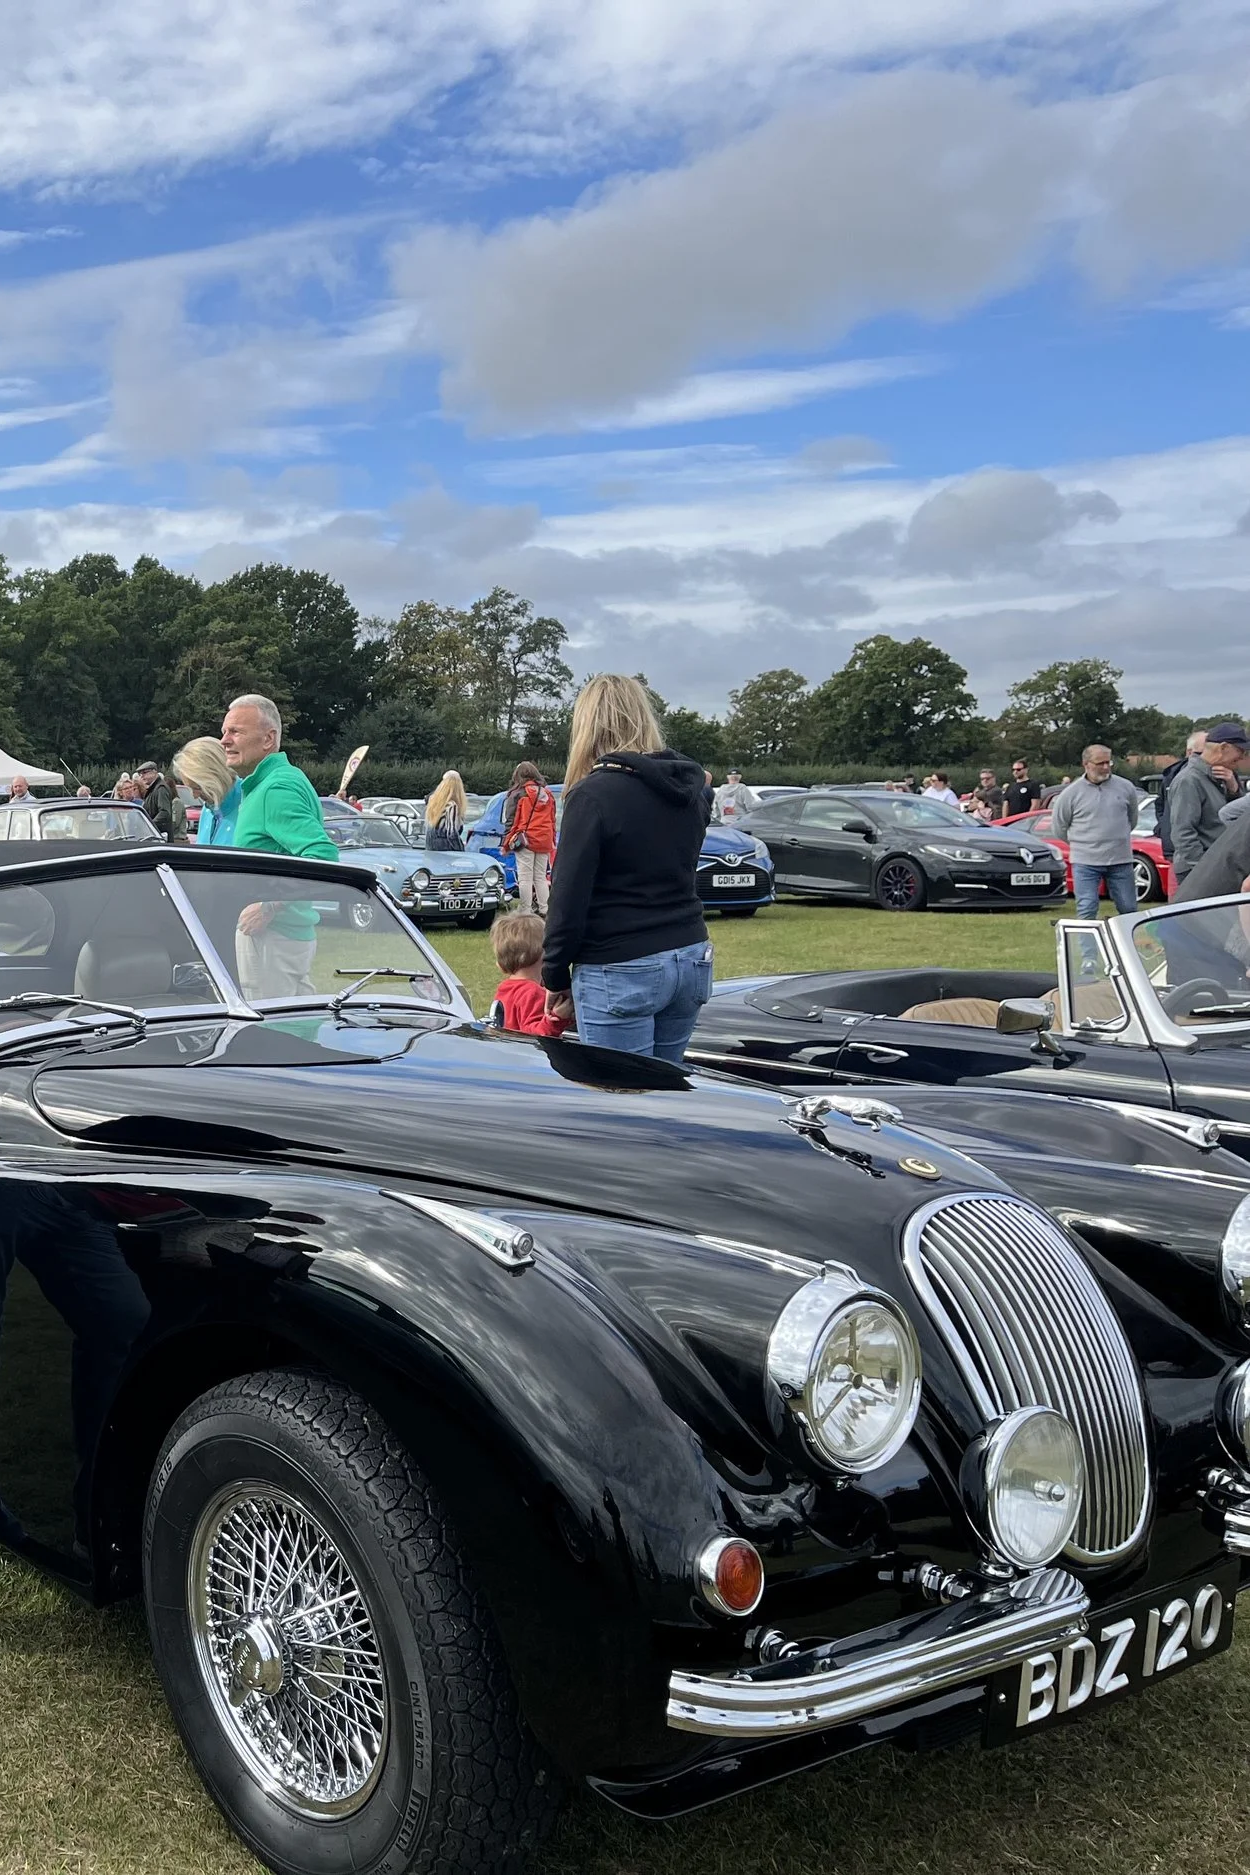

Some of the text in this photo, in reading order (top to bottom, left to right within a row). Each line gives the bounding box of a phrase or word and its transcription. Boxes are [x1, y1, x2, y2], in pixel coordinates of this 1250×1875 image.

[464, 899, 482, 909] 77E
[1016, 1583, 1223, 1728] BDZ 120
[410, 1680, 424, 1770] CINTURATO
